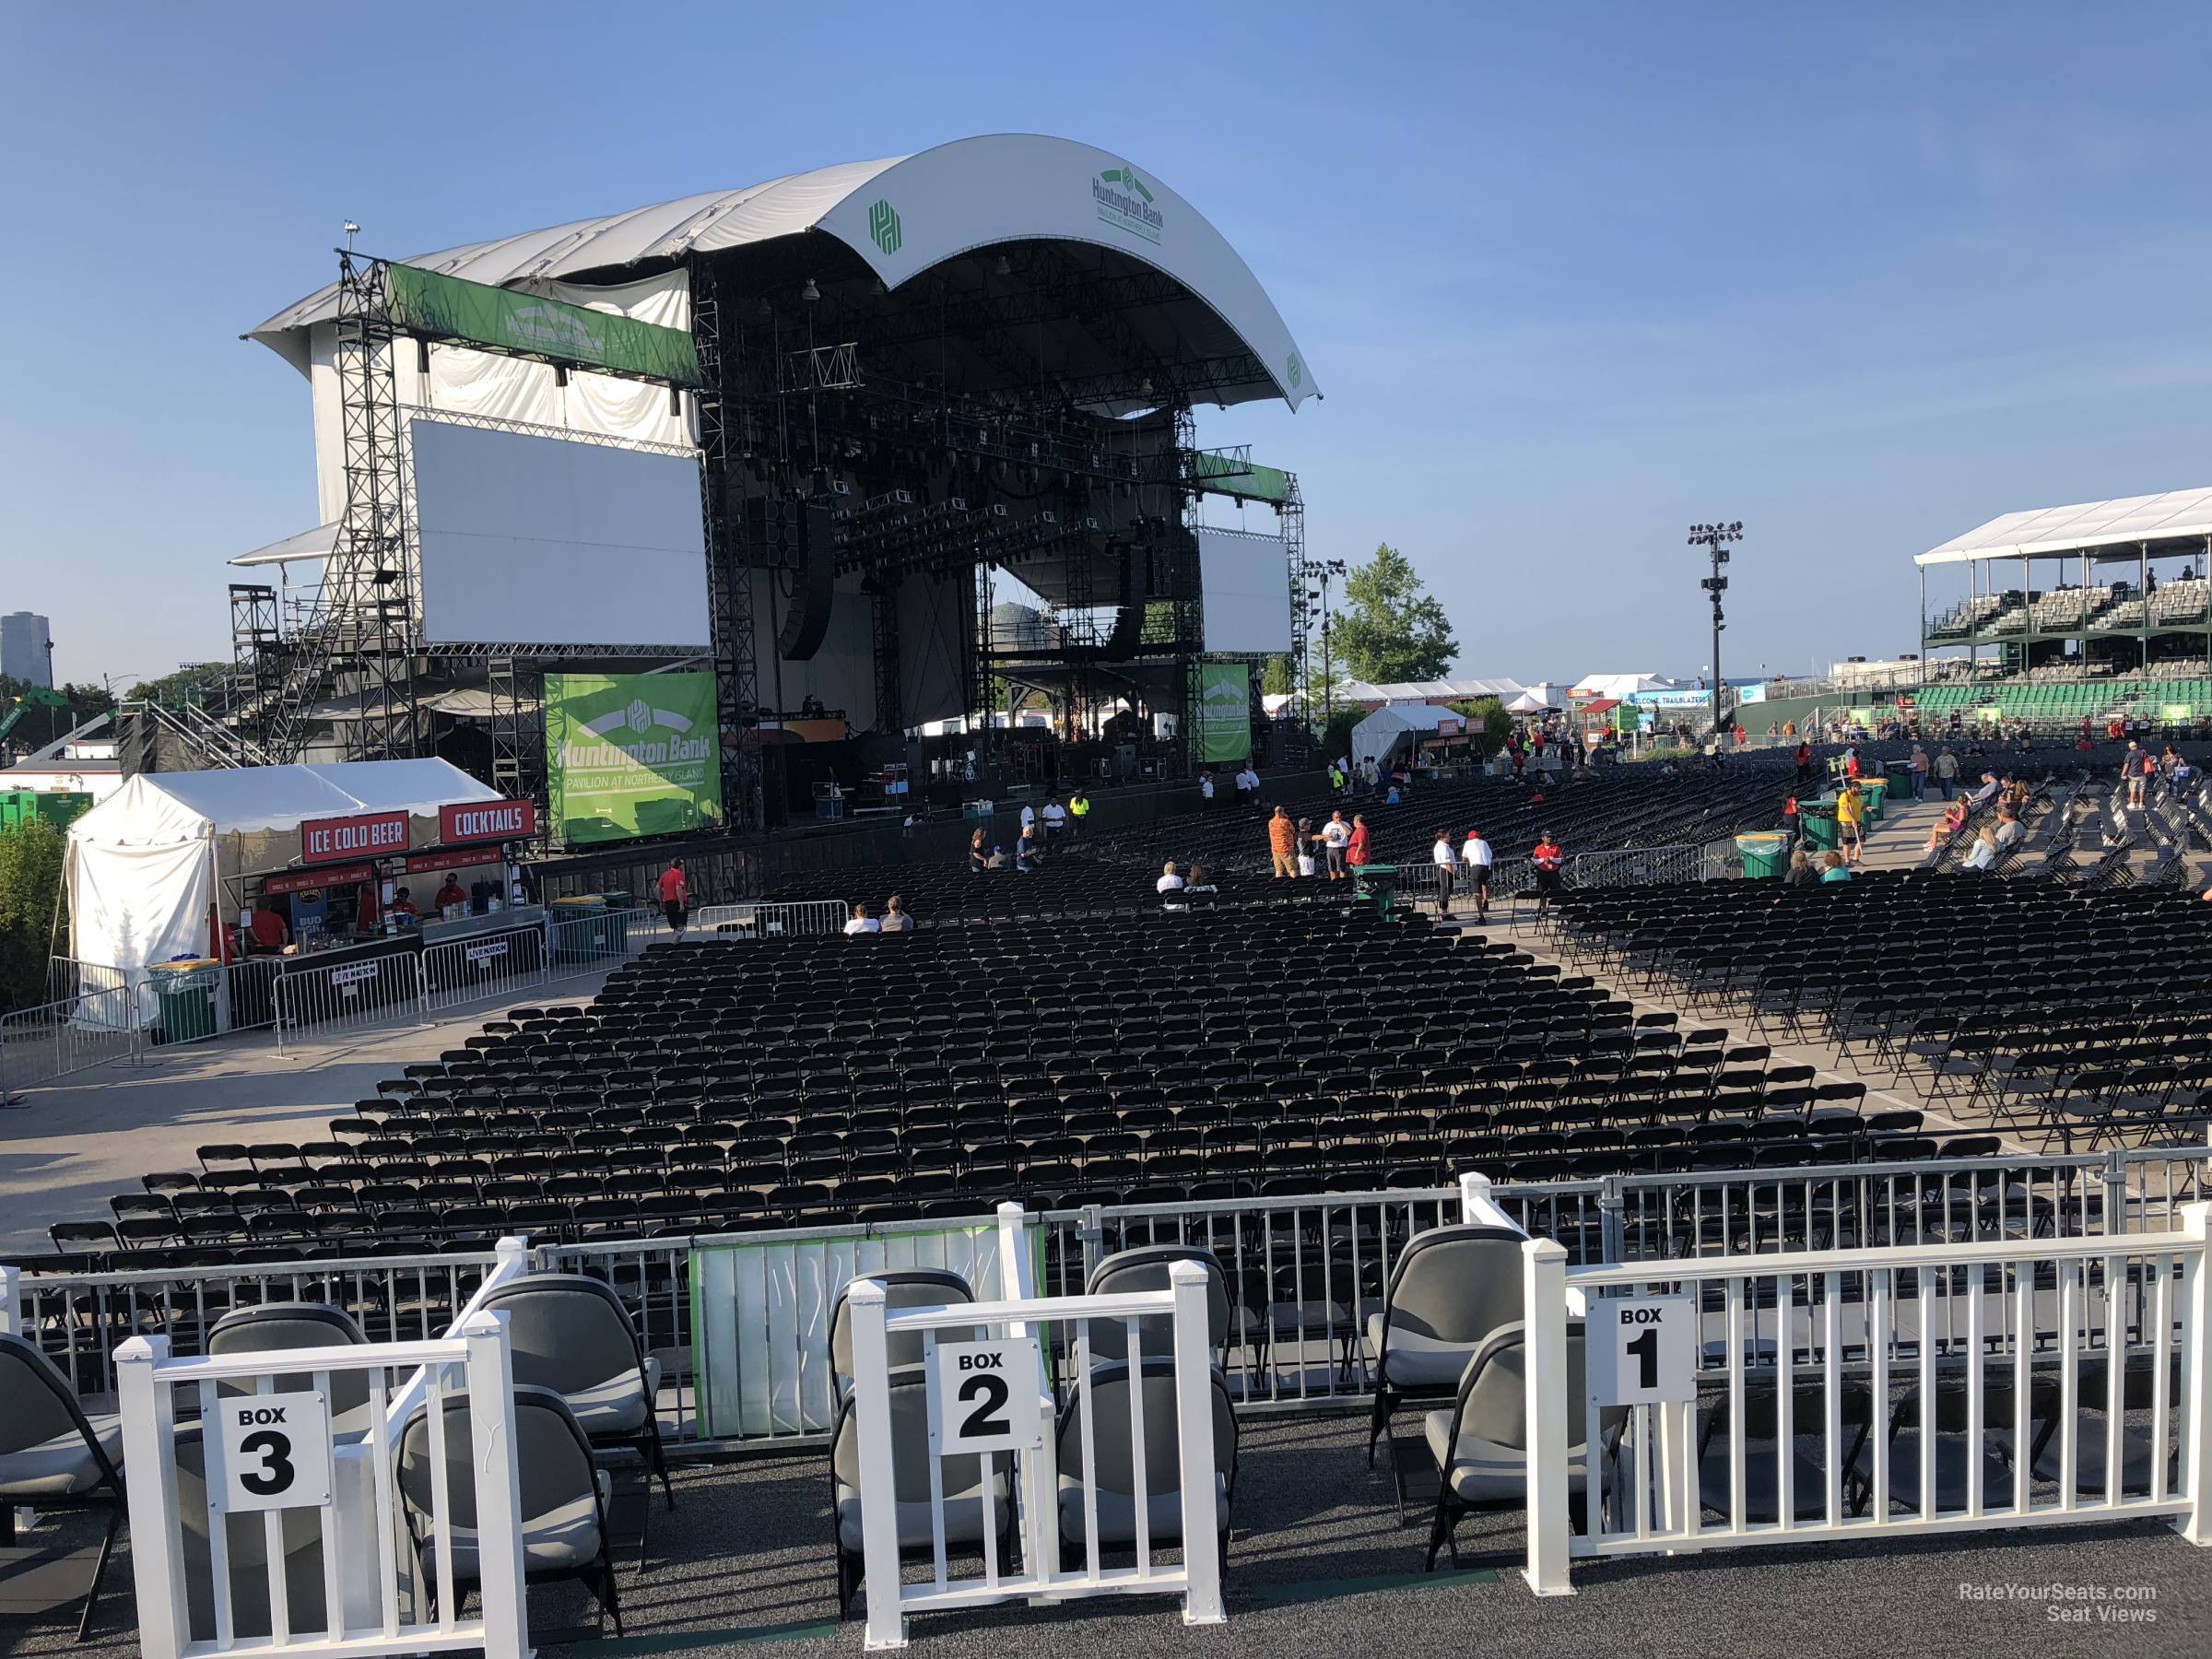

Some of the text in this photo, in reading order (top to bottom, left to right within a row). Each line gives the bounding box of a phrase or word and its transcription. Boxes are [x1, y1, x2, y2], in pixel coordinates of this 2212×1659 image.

[1092, 176, 1163, 229] Huntington Bank
[557, 734, 711, 772] Huntington Bank
[566, 768, 704, 790] PAVILION AT NORTHERLY ISLAND
[455, 807, 523, 836] COCKTAILS
[310, 821, 403, 853] ICE COLD BEER
[299, 915, 323, 926] BUD
[1620, 1308, 1663, 1324] BOX
[959, 1352, 1003, 1371] BOX
[1627, 1328, 1658, 1388] 1
[239, 1407, 287, 1426] BOX
[959, 1373, 1011, 1438] 2
[240, 1430, 295, 1496] 3
